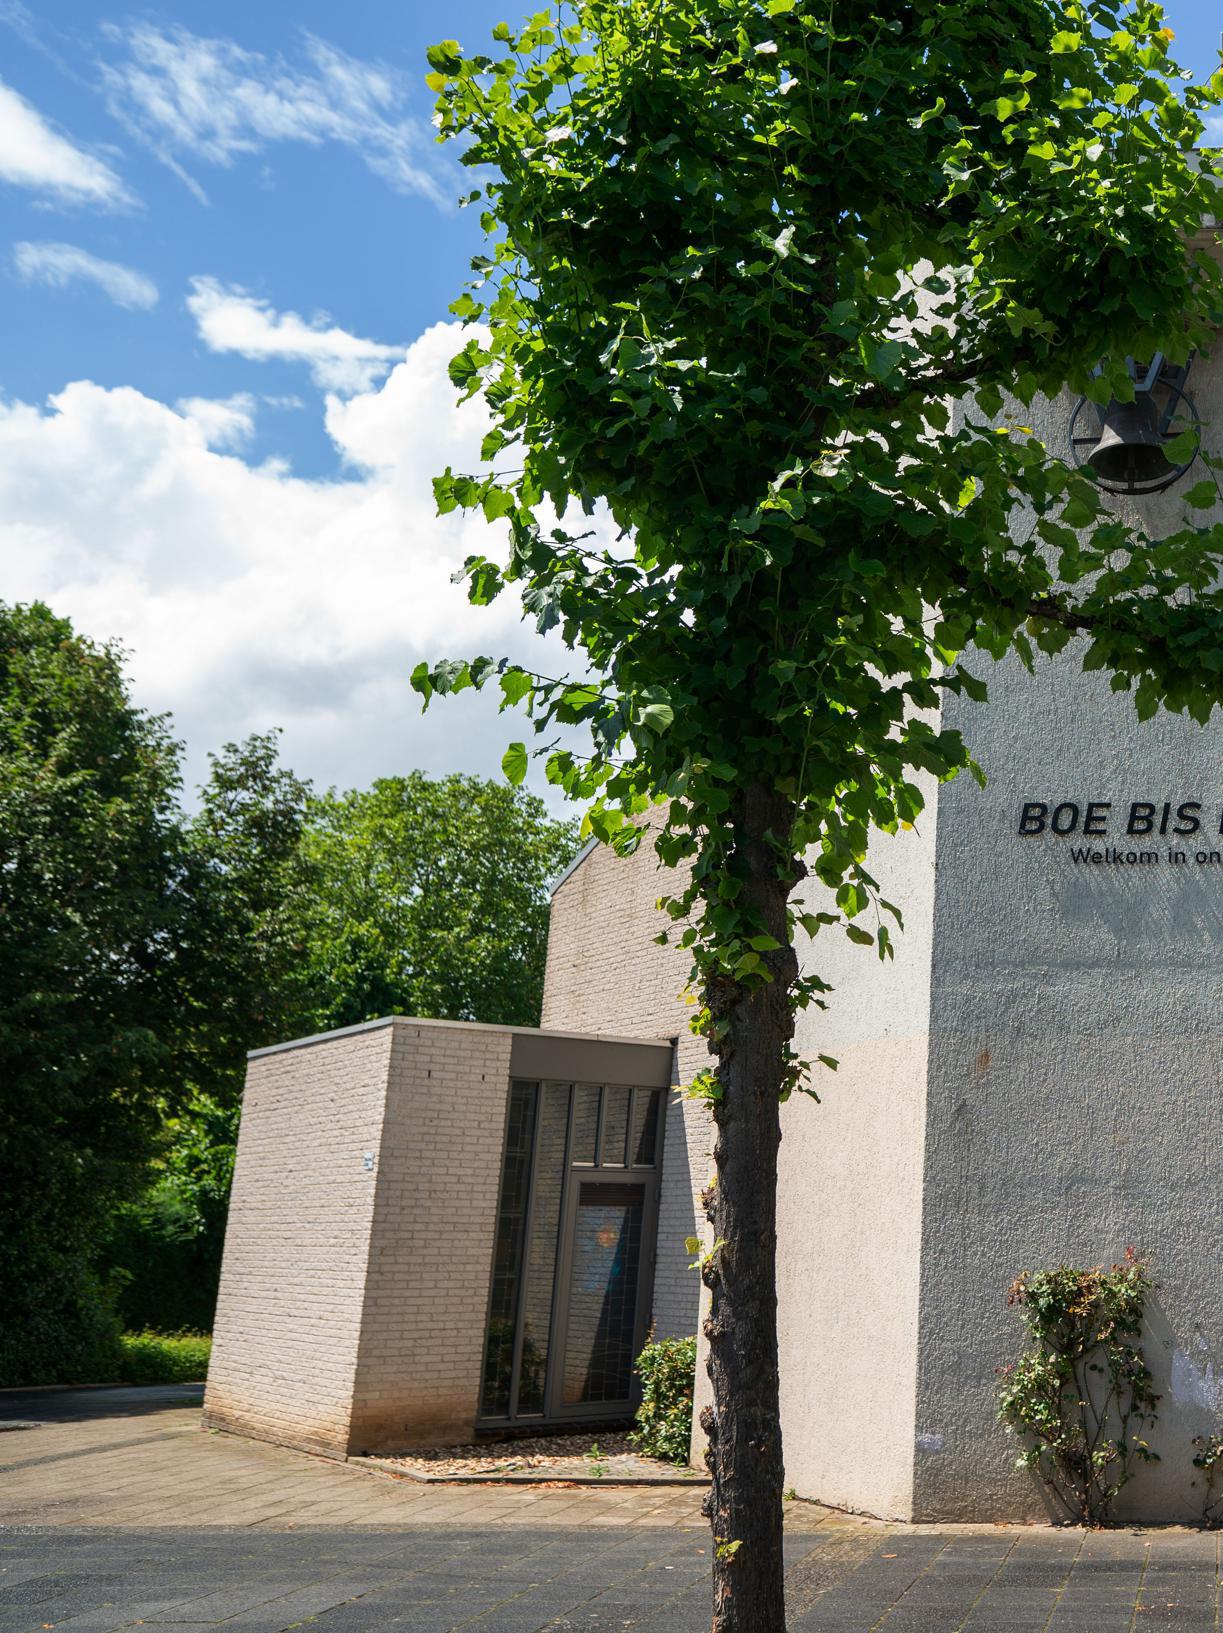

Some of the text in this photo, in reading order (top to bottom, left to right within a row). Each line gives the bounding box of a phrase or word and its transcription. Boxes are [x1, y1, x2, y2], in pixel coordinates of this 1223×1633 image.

[1018, 802, 1111, 836] BOE
[1126, 802, 1202, 836] BIS
[1070, 847, 1159, 865] Welkom
[1167, 847, 1187, 864] in
